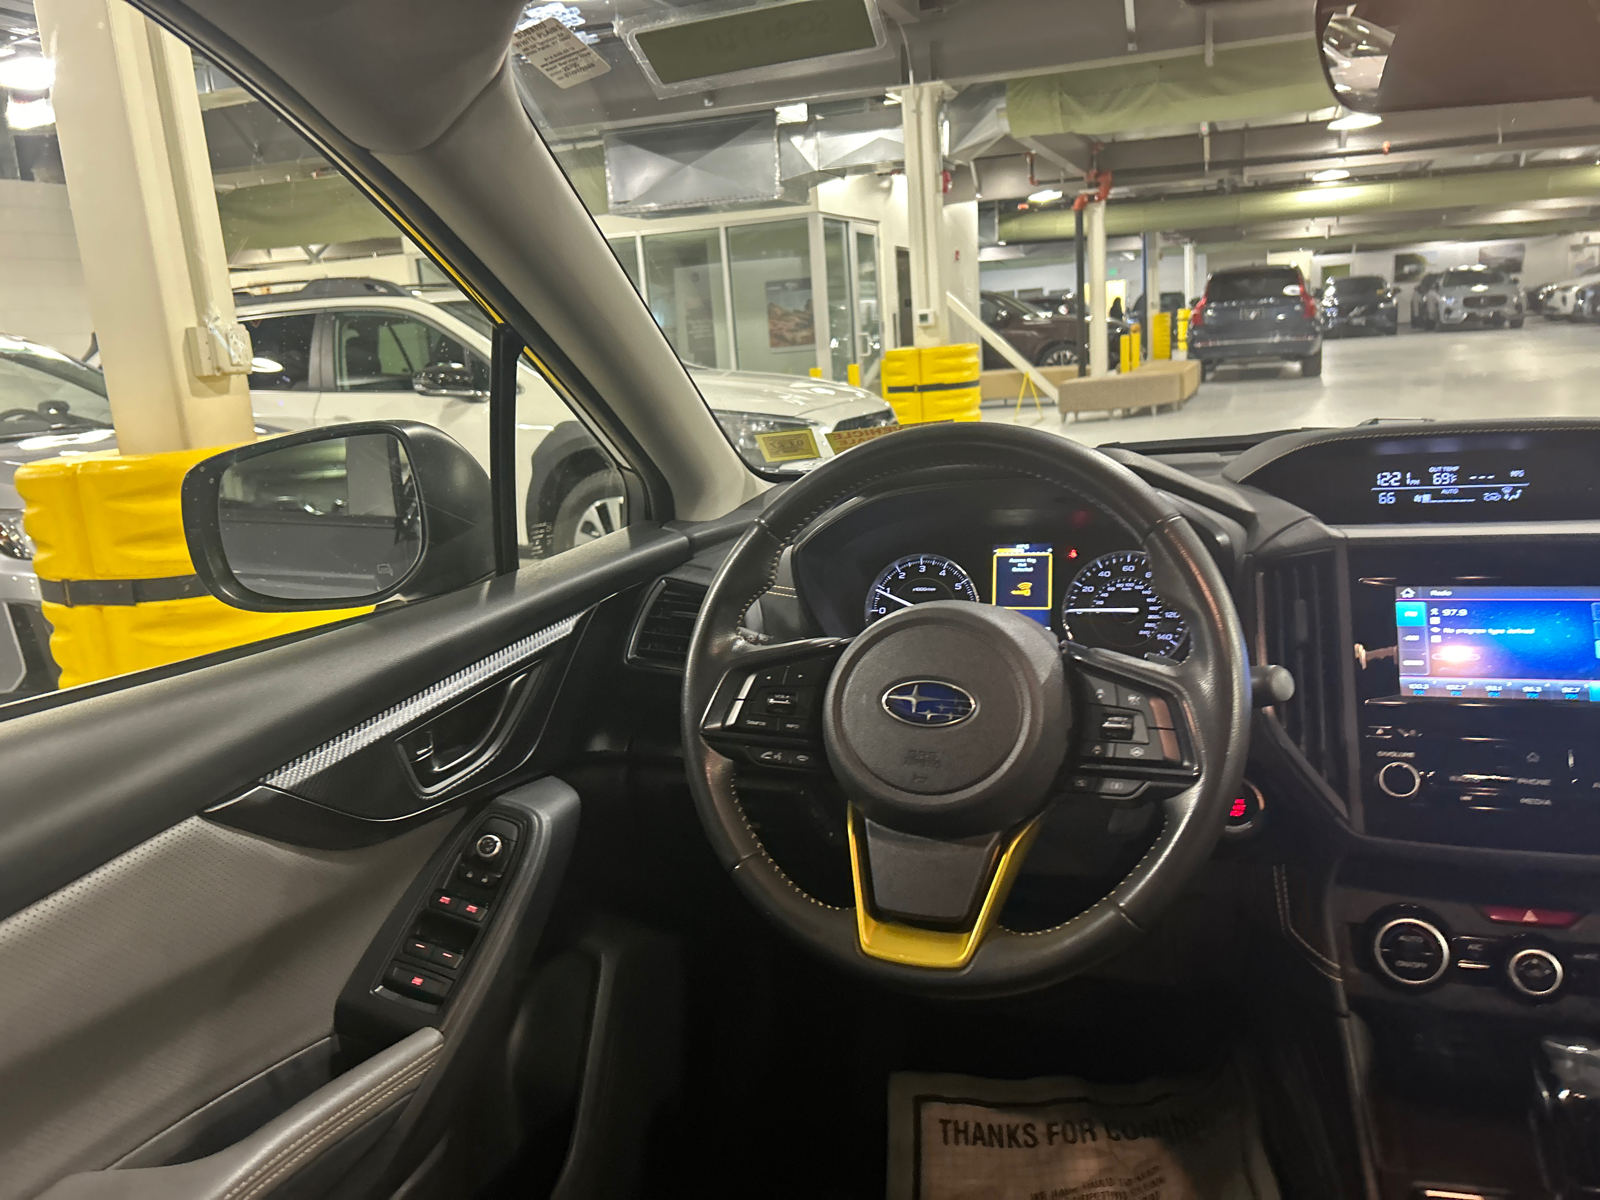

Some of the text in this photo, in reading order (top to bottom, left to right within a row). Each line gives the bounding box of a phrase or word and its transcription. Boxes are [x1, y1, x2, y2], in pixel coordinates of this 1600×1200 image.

[514, 22, 547, 39] SUBARU
[537, 24, 562, 38] PLAINS
[1378, 492, 1396, 504] 66
[898, 572, 906, 580] 2
[954, 582, 962, 590] 5
[1442, 608, 1468, 617] 97.9
[938, 1118, 1040, 1149] THANKS
[1046, 1118, 1098, 1147] FOR
